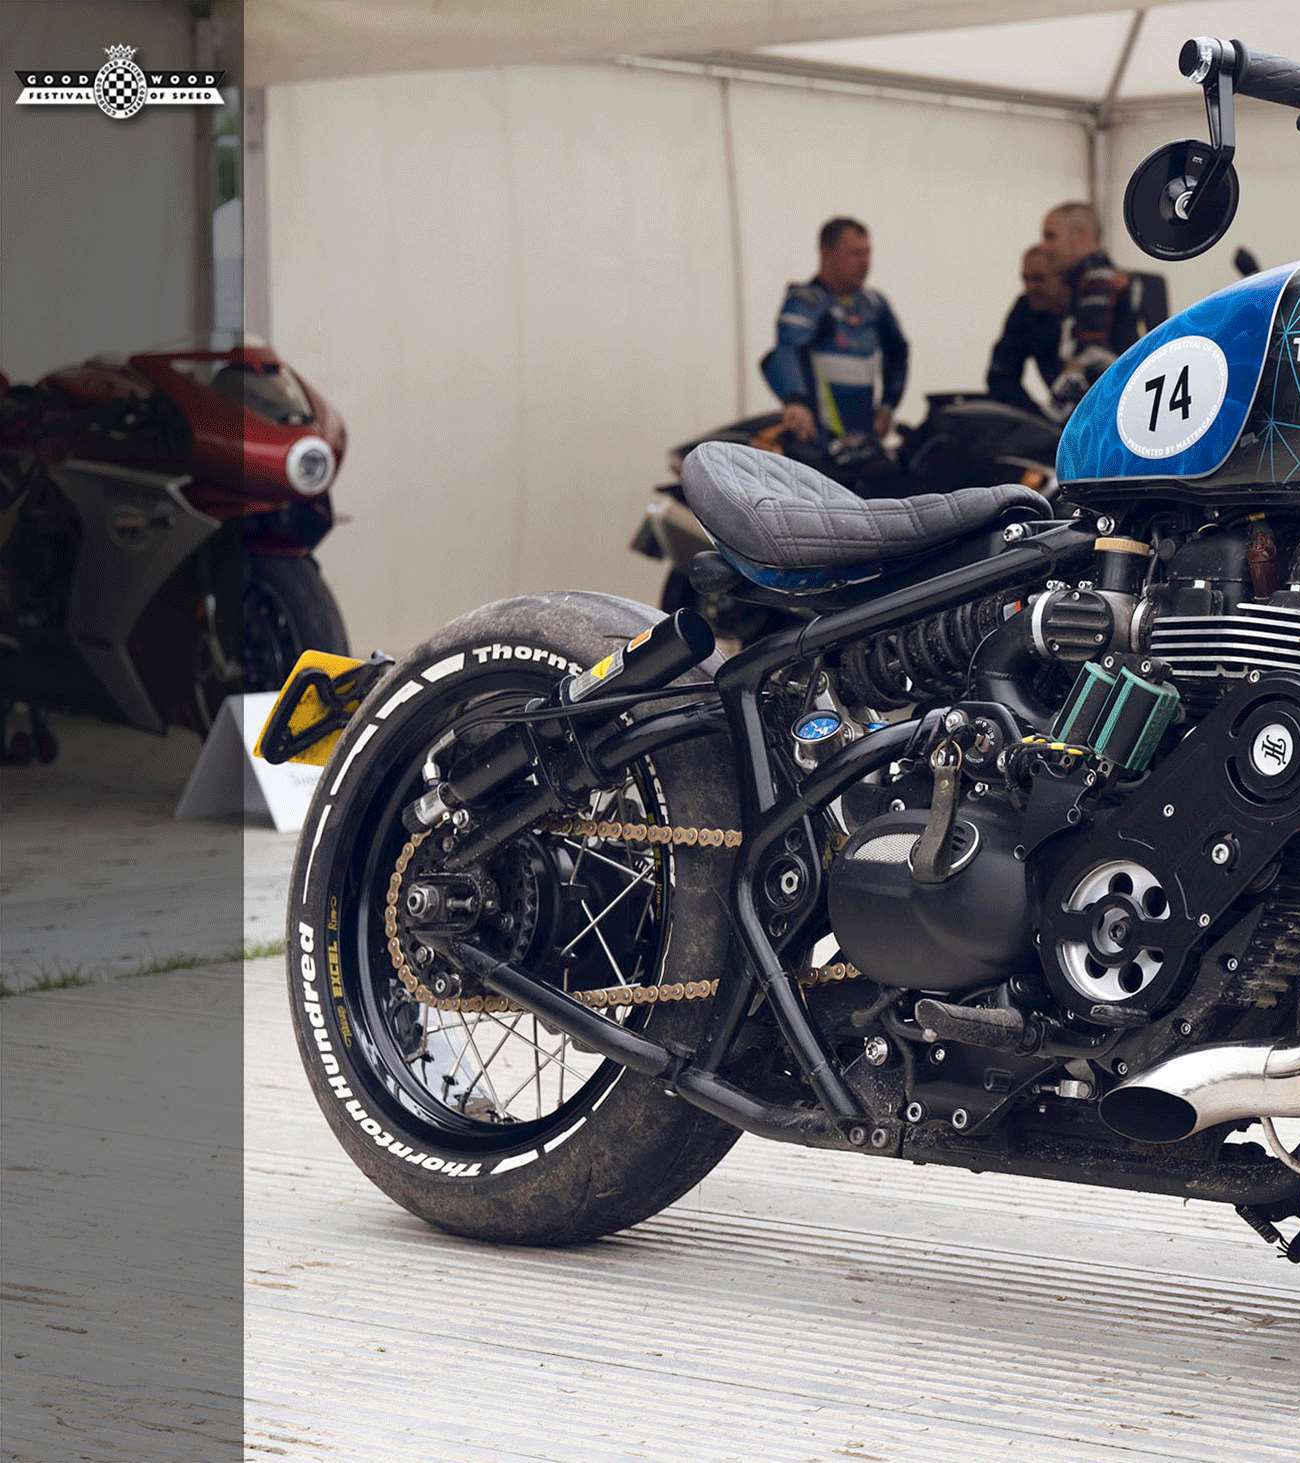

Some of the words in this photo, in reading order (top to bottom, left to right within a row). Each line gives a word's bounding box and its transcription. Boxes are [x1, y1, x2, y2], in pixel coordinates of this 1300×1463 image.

[1145, 365, 1192, 432] 74
[472, 643, 583, 676] Thornt
[328, 940, 343, 998] EXCEL
[299, 921, 353, 1100] Hundred
[345, 1098, 482, 1177] Thornton
